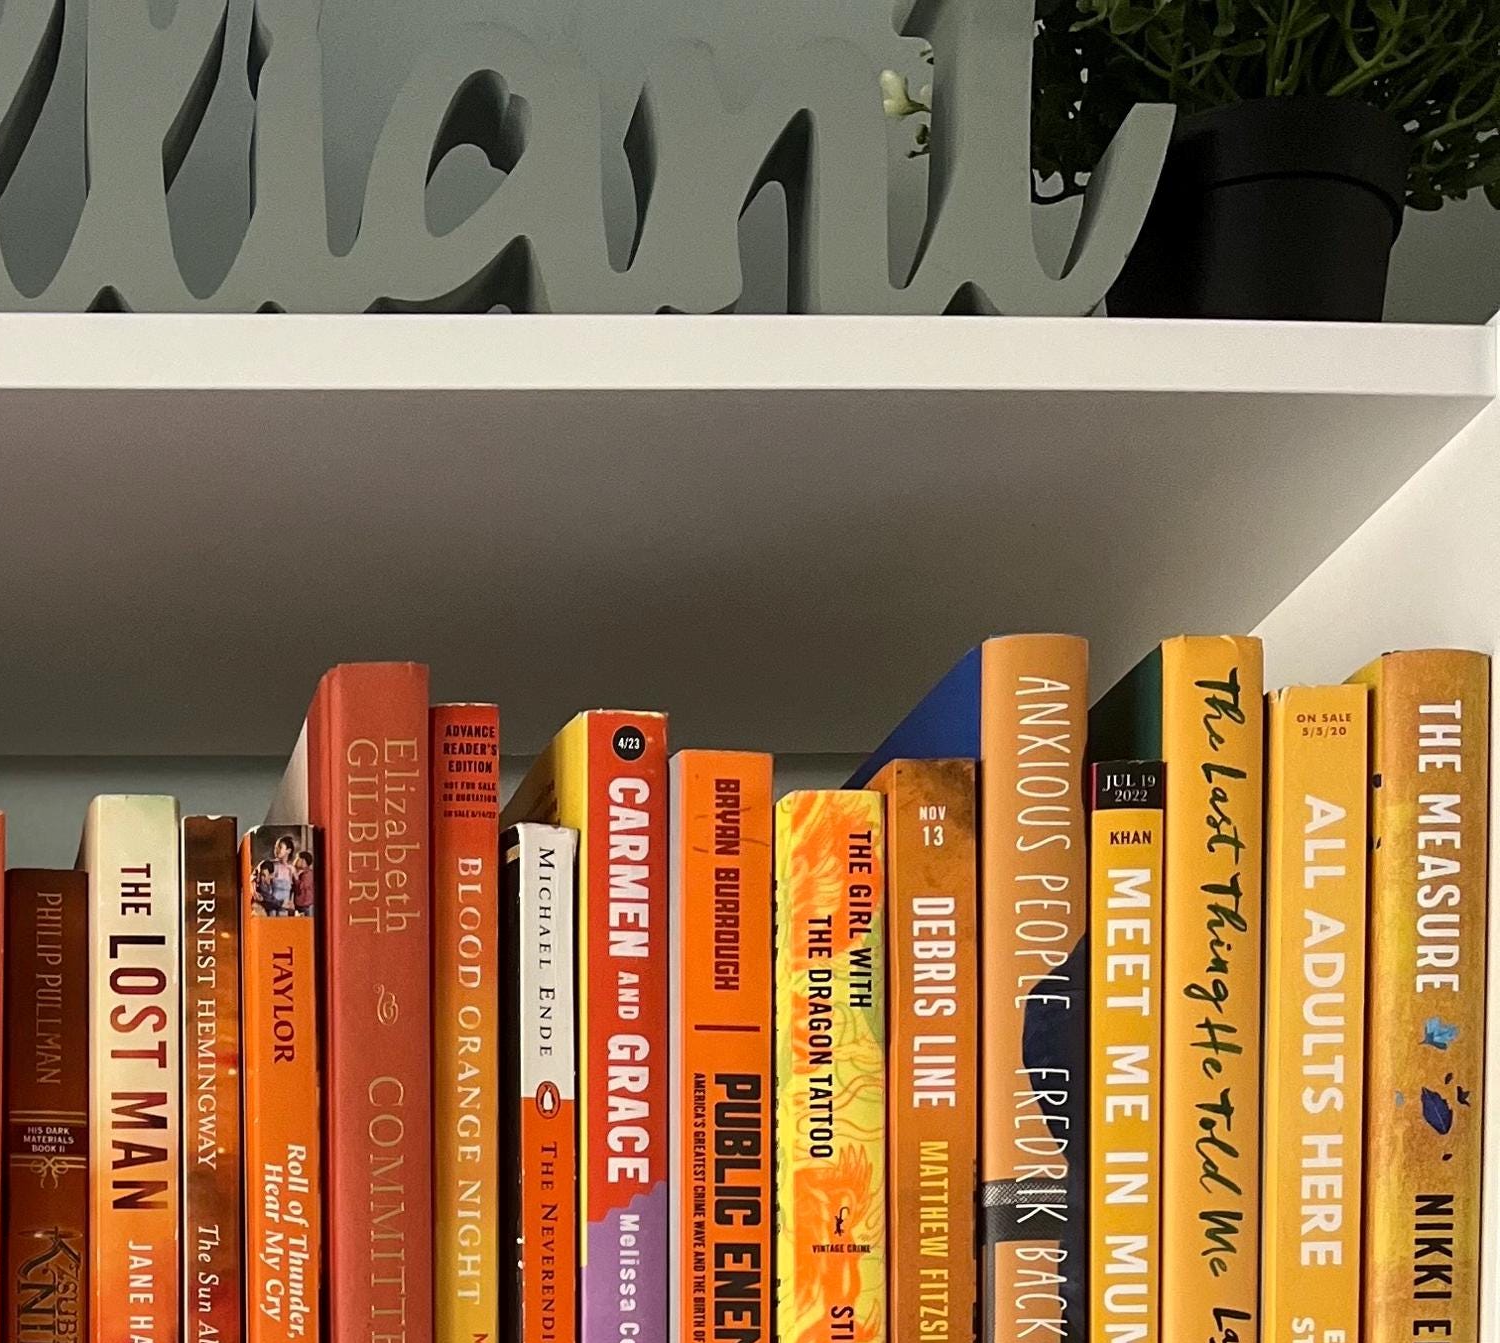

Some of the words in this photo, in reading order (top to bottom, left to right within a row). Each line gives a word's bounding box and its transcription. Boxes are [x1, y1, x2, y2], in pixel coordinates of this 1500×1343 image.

[443, 742, 497, 756] READER'S
[445, 725, 496, 738] ADVANCE
[617, 737, 641, 750] 4/23
[1296, 713, 1317, 723] ON
[1322, 713, 1353, 723] SALE
[1301, 726, 1348, 738] 5/5/20
[1417, 699, 1462, 773] THE
[448, 760, 493, 773] EDITION
[1015, 675, 1071, 852] ANXIOUS
[1114, 790, 1149, 803] 2022
[1141, 774, 1157, 788] 19
[346, 737, 382, 934] GILBERT
[383, 736, 421, 934] Elizabeth
[919, 805, 946, 821] NOV
[1109, 829, 1152, 845] KHAN
[1303, 793, 1348, 890] ALL
[120, 863, 151, 916] THE
[538, 847, 556, 970] MICHAEL
[608, 777, 650, 957] CARMEN
[1416, 793, 1462, 994] MEASURE
[713, 867, 741, 991] BURROUGH
[848, 883, 872, 939] GIRL
[1014, 874, 1071, 1010] PEOPLE
[1106, 868, 1152, 1017] MEET
[1183, 872, 1248, 1014] Thing
[849, 947, 872, 1008] WITH
[912, 896, 957, 1018] DEBRIS
[109, 935, 168, 1069] LOST
[272, 946, 295, 1065] TAYLOR
[808, 968, 833, 1065] DRAGON
[1301, 908, 1346, 1115] ADULTS
[197, 999, 217, 1171] HEMINGWAY
[457, 1005, 482, 1163] ORANGE
[606, 1033, 650, 1184] GRACE
[692, 1072, 707, 1129] AMERICA'S
[912, 1035, 957, 1108] LINE
[1105, 1044, 1151, 1123] ME
[23, 1135, 74, 1145] MATERIALS
[31, 1144, 56, 1153] BOOK
[46, 1126, 70, 1135] DARK
[110, 1091, 169, 1210] MAN
[692, 1131, 707, 1183] GREATEST
[714, 1073, 761, 1227] PUBLIC
[809, 1073, 834, 1159] TATTOO
[1012, 1067, 1071, 1224] FREDRIK
[1194, 1087, 1243, 1196] Told
[692, 1185, 706, 1218] CRIME
[919, 1140, 949, 1258] MATTHEW
[1104, 1151, 1149, 1205] IN
[1300, 1133, 1344, 1267] HERE
[619, 1213, 641, 1312] Melissa
[692, 1221, 706, 1249] WAVE
[692, 1251, 706, 1272] AND
[812, 1243, 845, 1253] VINTAGE
[847, 1243, 872, 1254] CRIME
[1413, 1194, 1455, 1300] NIKKI
[286, 1234, 311, 1340] Thunder,
[692, 1274, 706, 1294] THE
[692, 1297, 706, 1328] BIRTH
